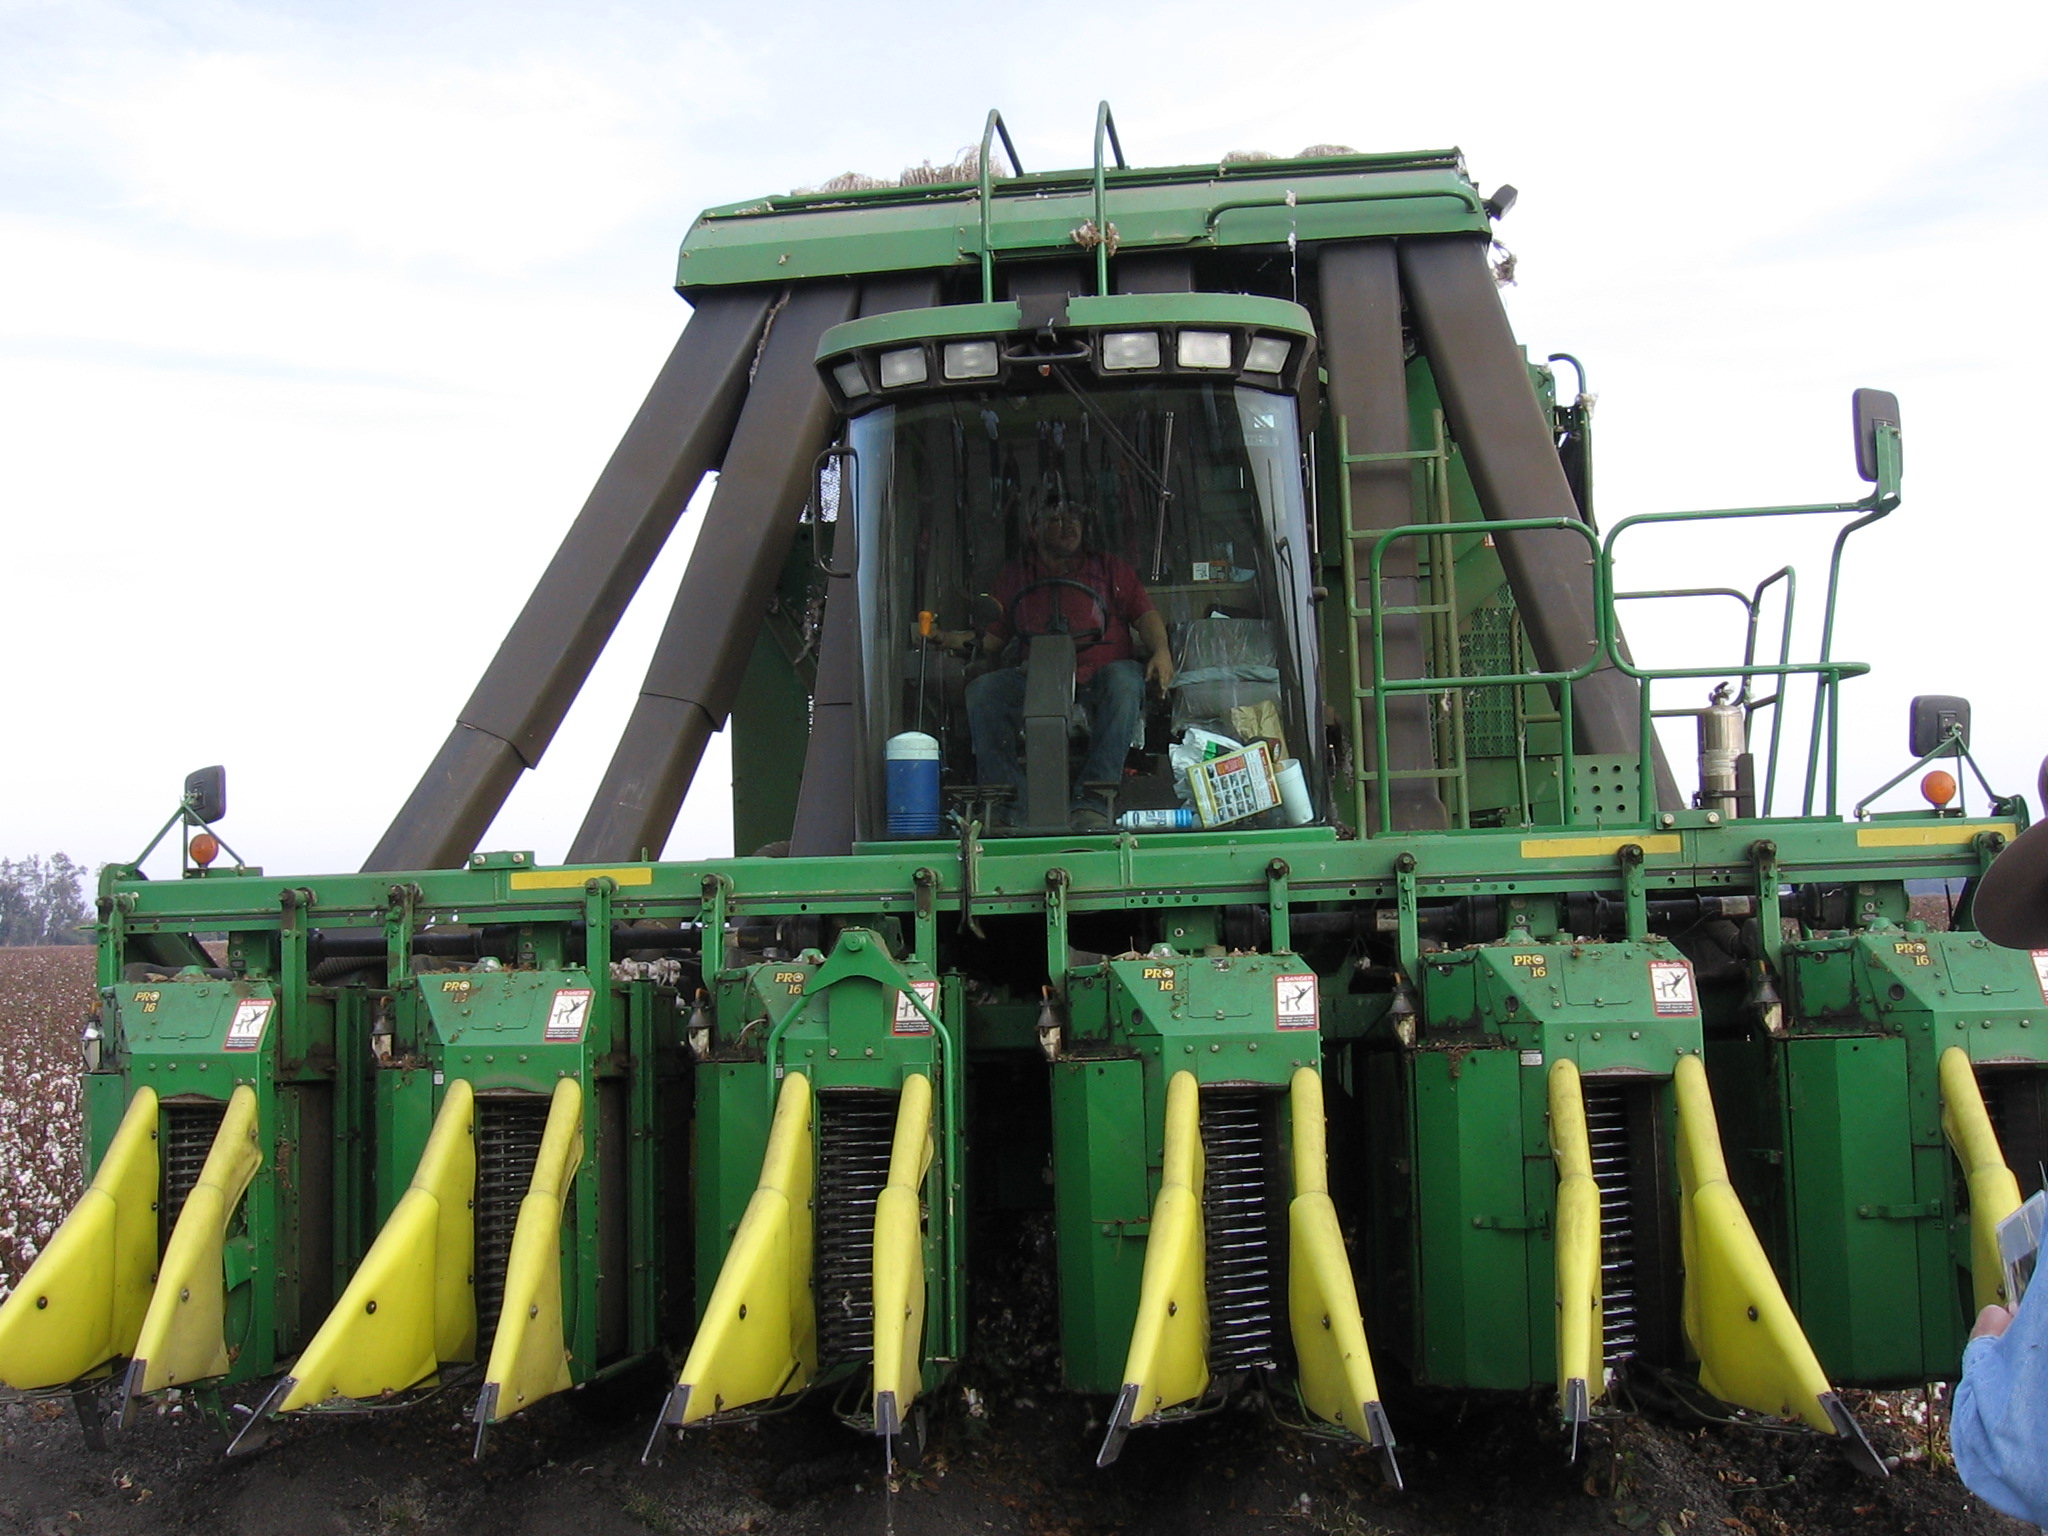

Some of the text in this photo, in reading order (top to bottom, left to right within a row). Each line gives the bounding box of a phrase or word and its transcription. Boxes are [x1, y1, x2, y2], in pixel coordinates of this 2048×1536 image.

[1895, 943, 1926, 953] PRO
[1513, 955, 1545, 966] PRO
[1915, 955, 1930, 966] 16
[1144, 968, 1174, 979] PRO
[1532, 966, 1546, 977] 16
[775, 972, 804, 983] PRO
[442, 981, 471, 992] PRO
[788, 984, 802, 995] 16
[1159, 980, 1174, 991] 16
[134, 991, 161, 1002] PRO
[143, 1002, 157, 1013] 16
